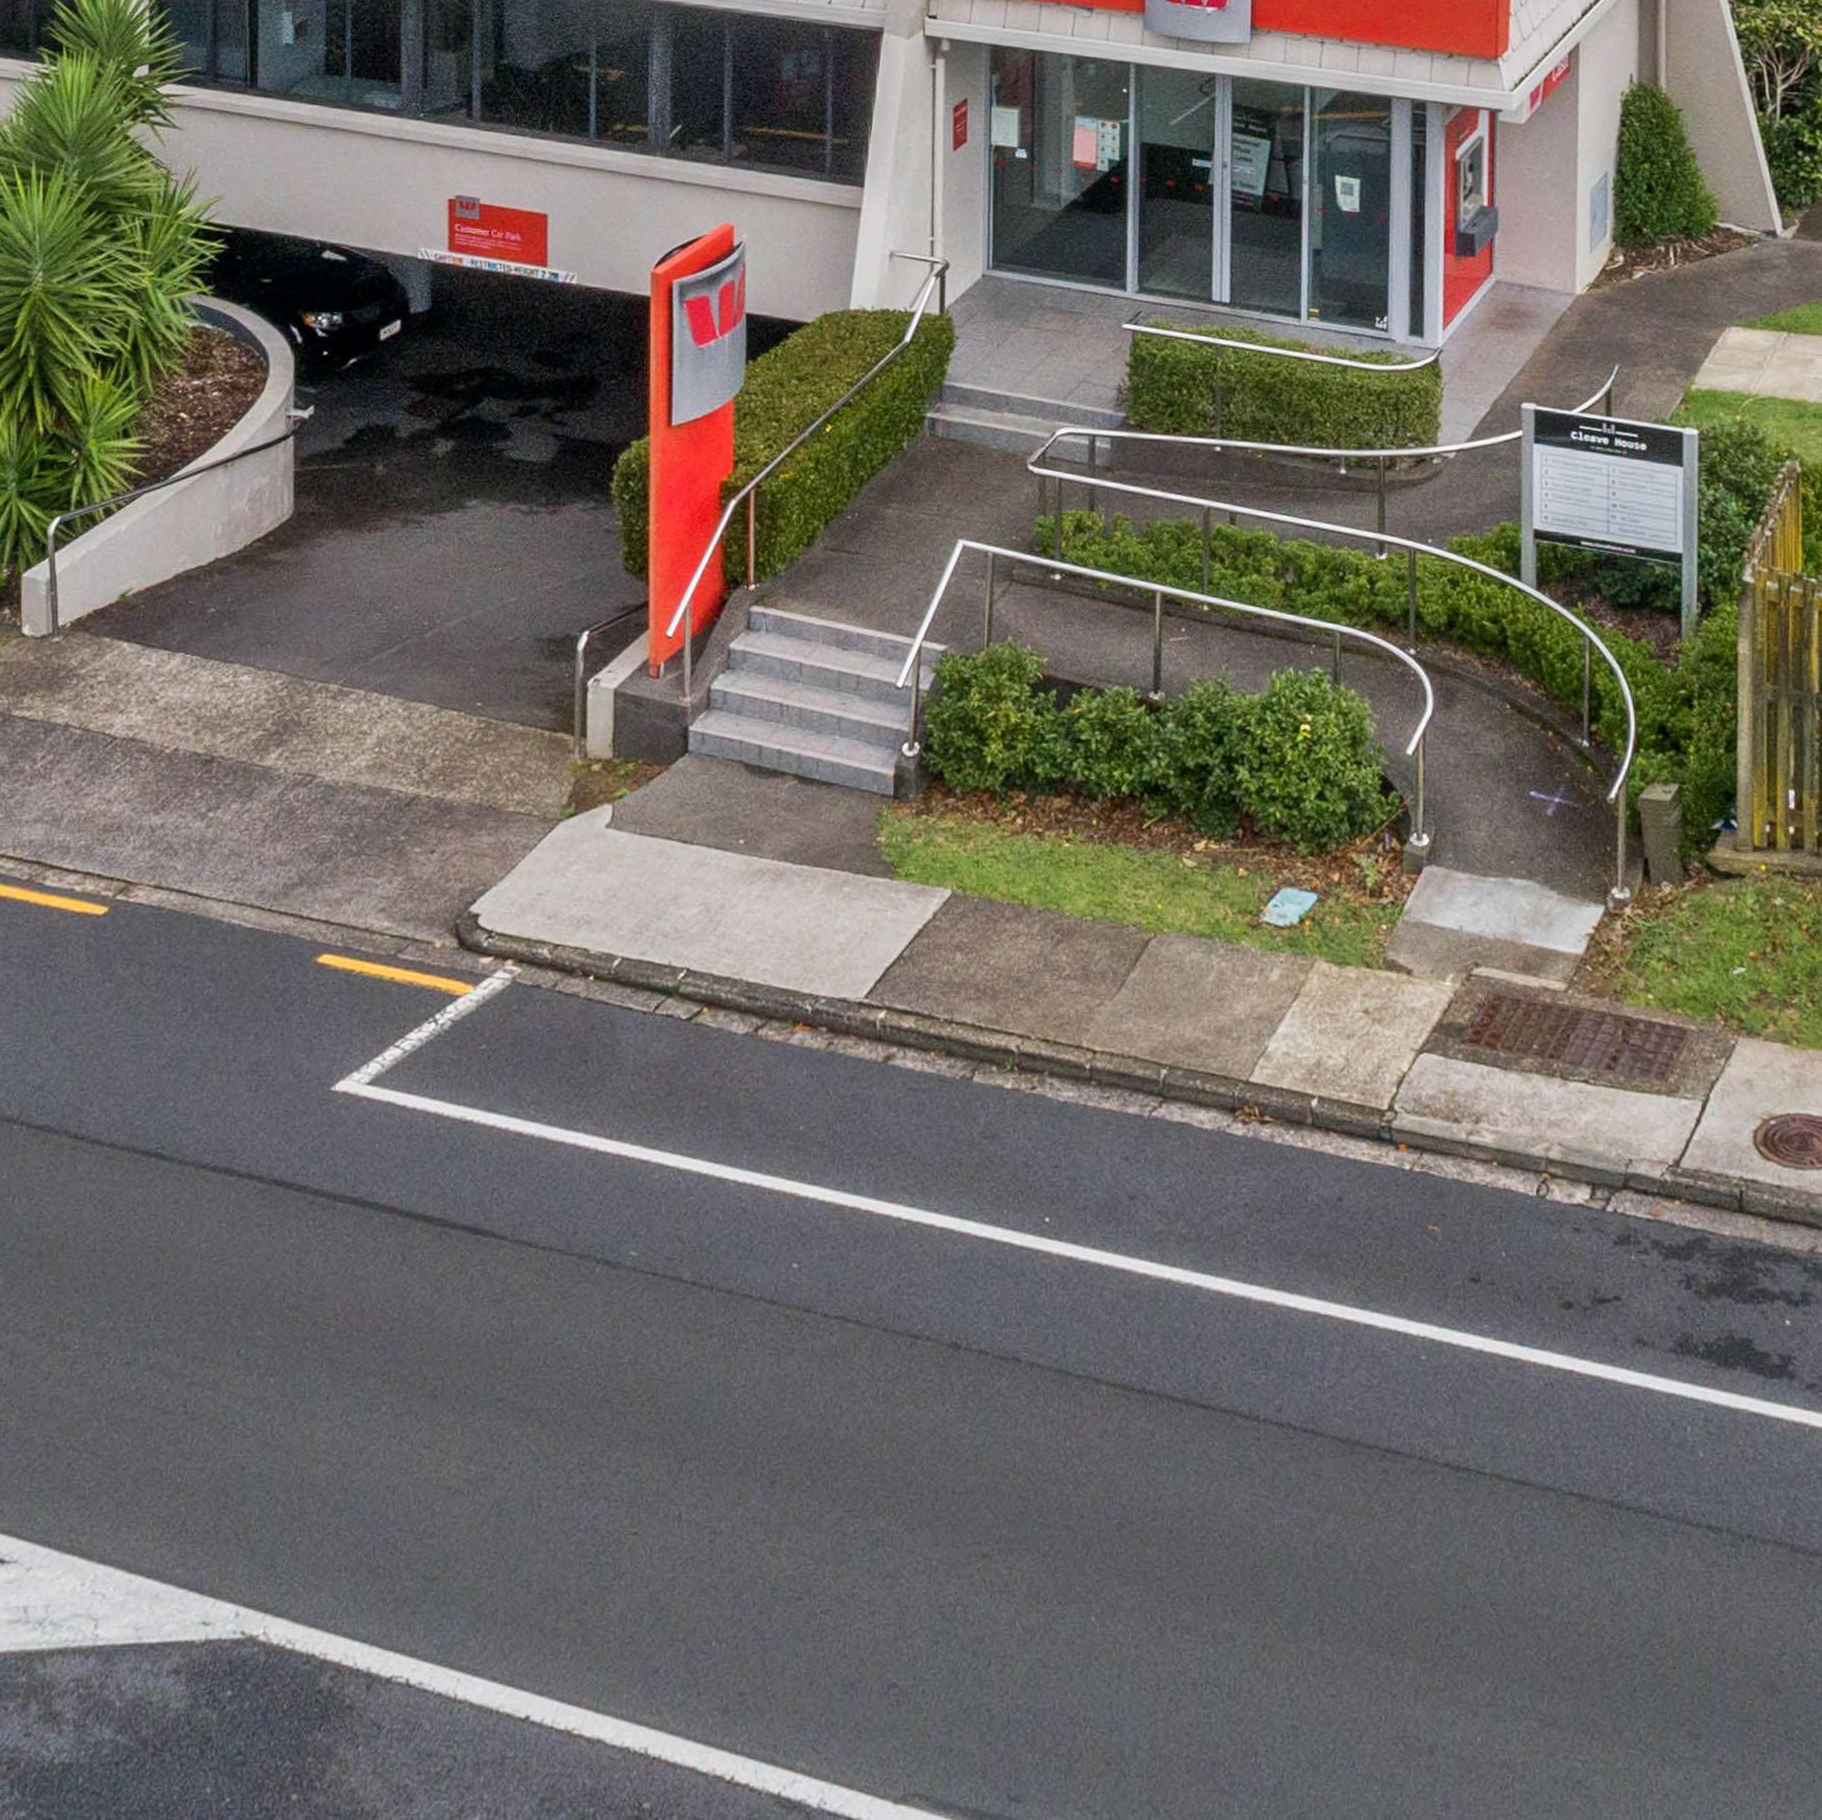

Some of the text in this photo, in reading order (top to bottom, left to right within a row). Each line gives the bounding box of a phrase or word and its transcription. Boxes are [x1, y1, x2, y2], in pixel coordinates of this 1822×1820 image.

[491, 228, 505, 239] Car
[505, 231, 522, 242] Park
[1570, 430, 1610, 445] Cleave
[1614, 437, 1648, 451] House
